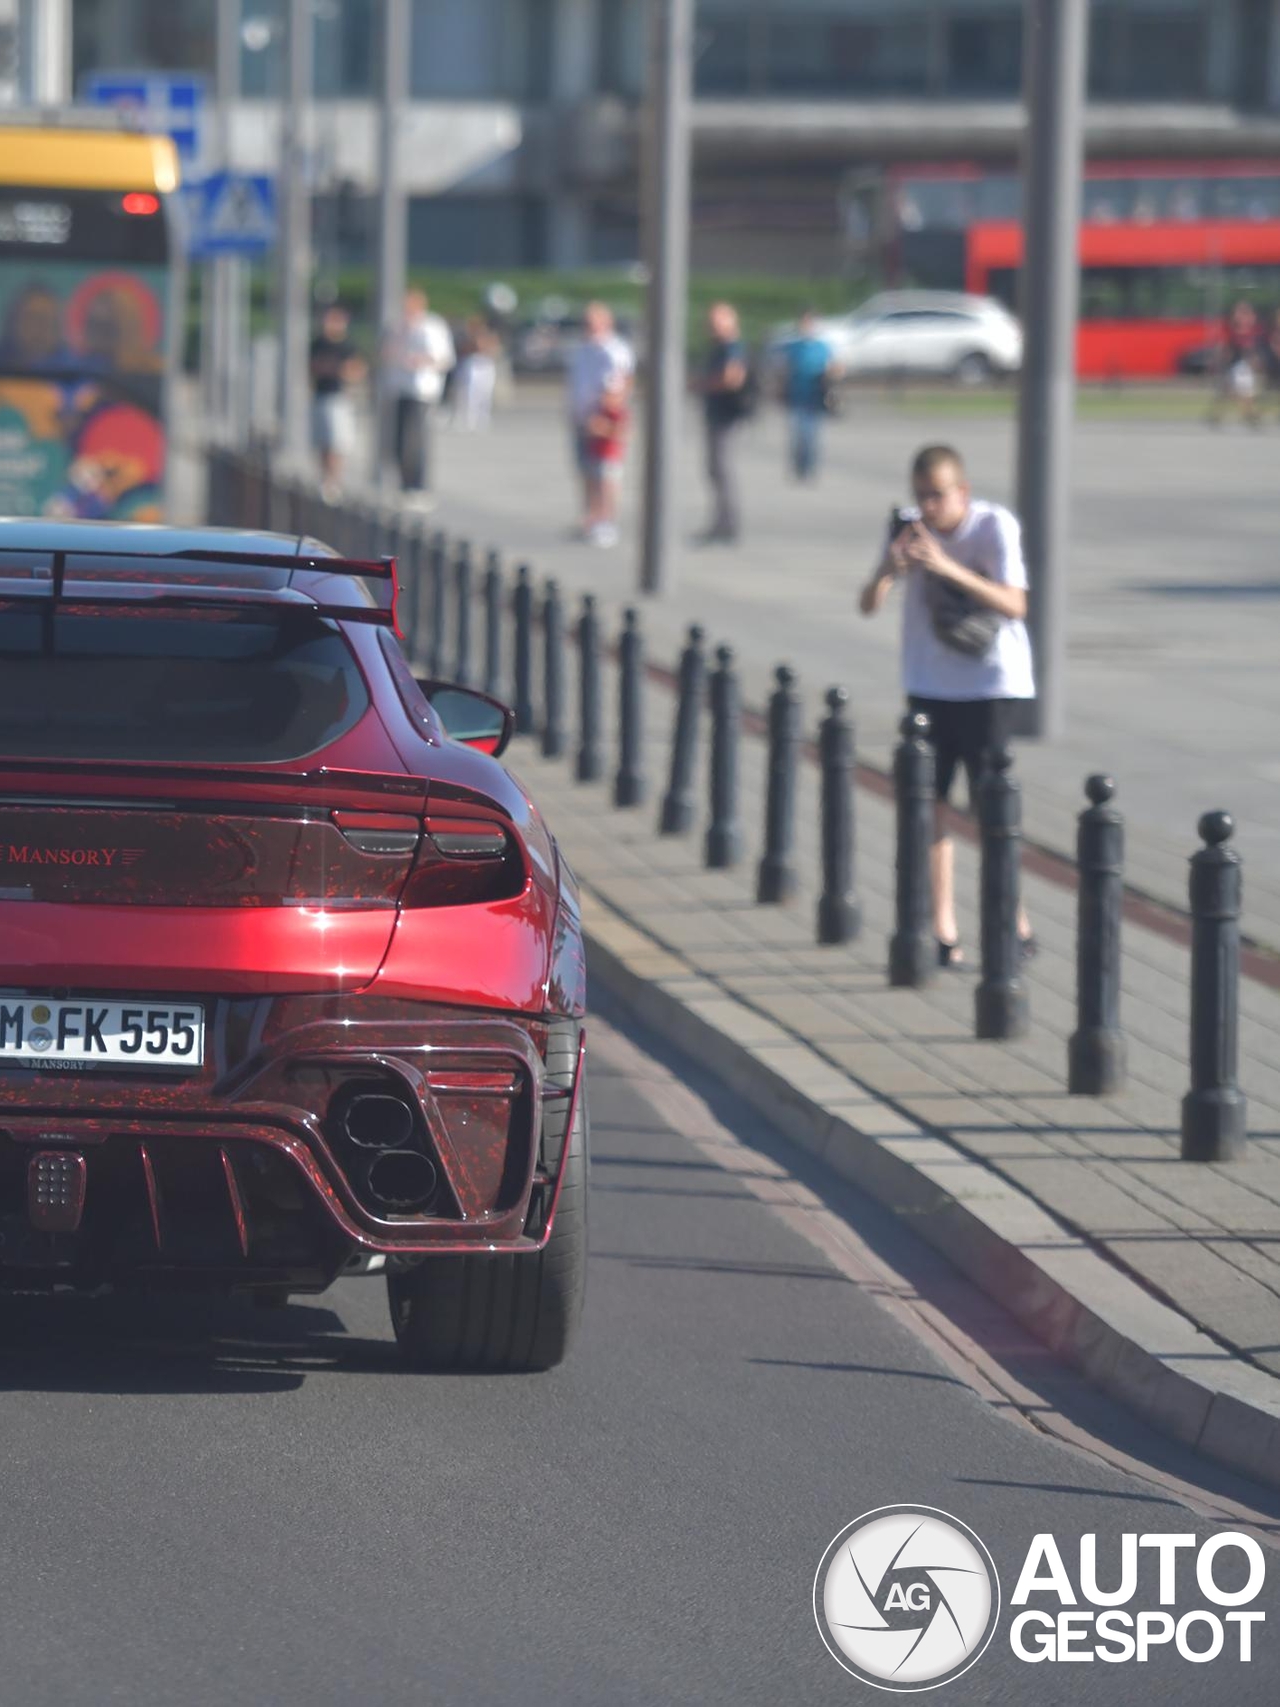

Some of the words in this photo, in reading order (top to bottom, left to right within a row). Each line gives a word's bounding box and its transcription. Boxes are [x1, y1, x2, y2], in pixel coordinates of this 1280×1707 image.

[8, 845, 117, 866] MANSORY
[56, 1007, 109, 1053] FK
[120, 1009, 195, 1056] 555
[31, 1059, 85, 1070] MANSORY
